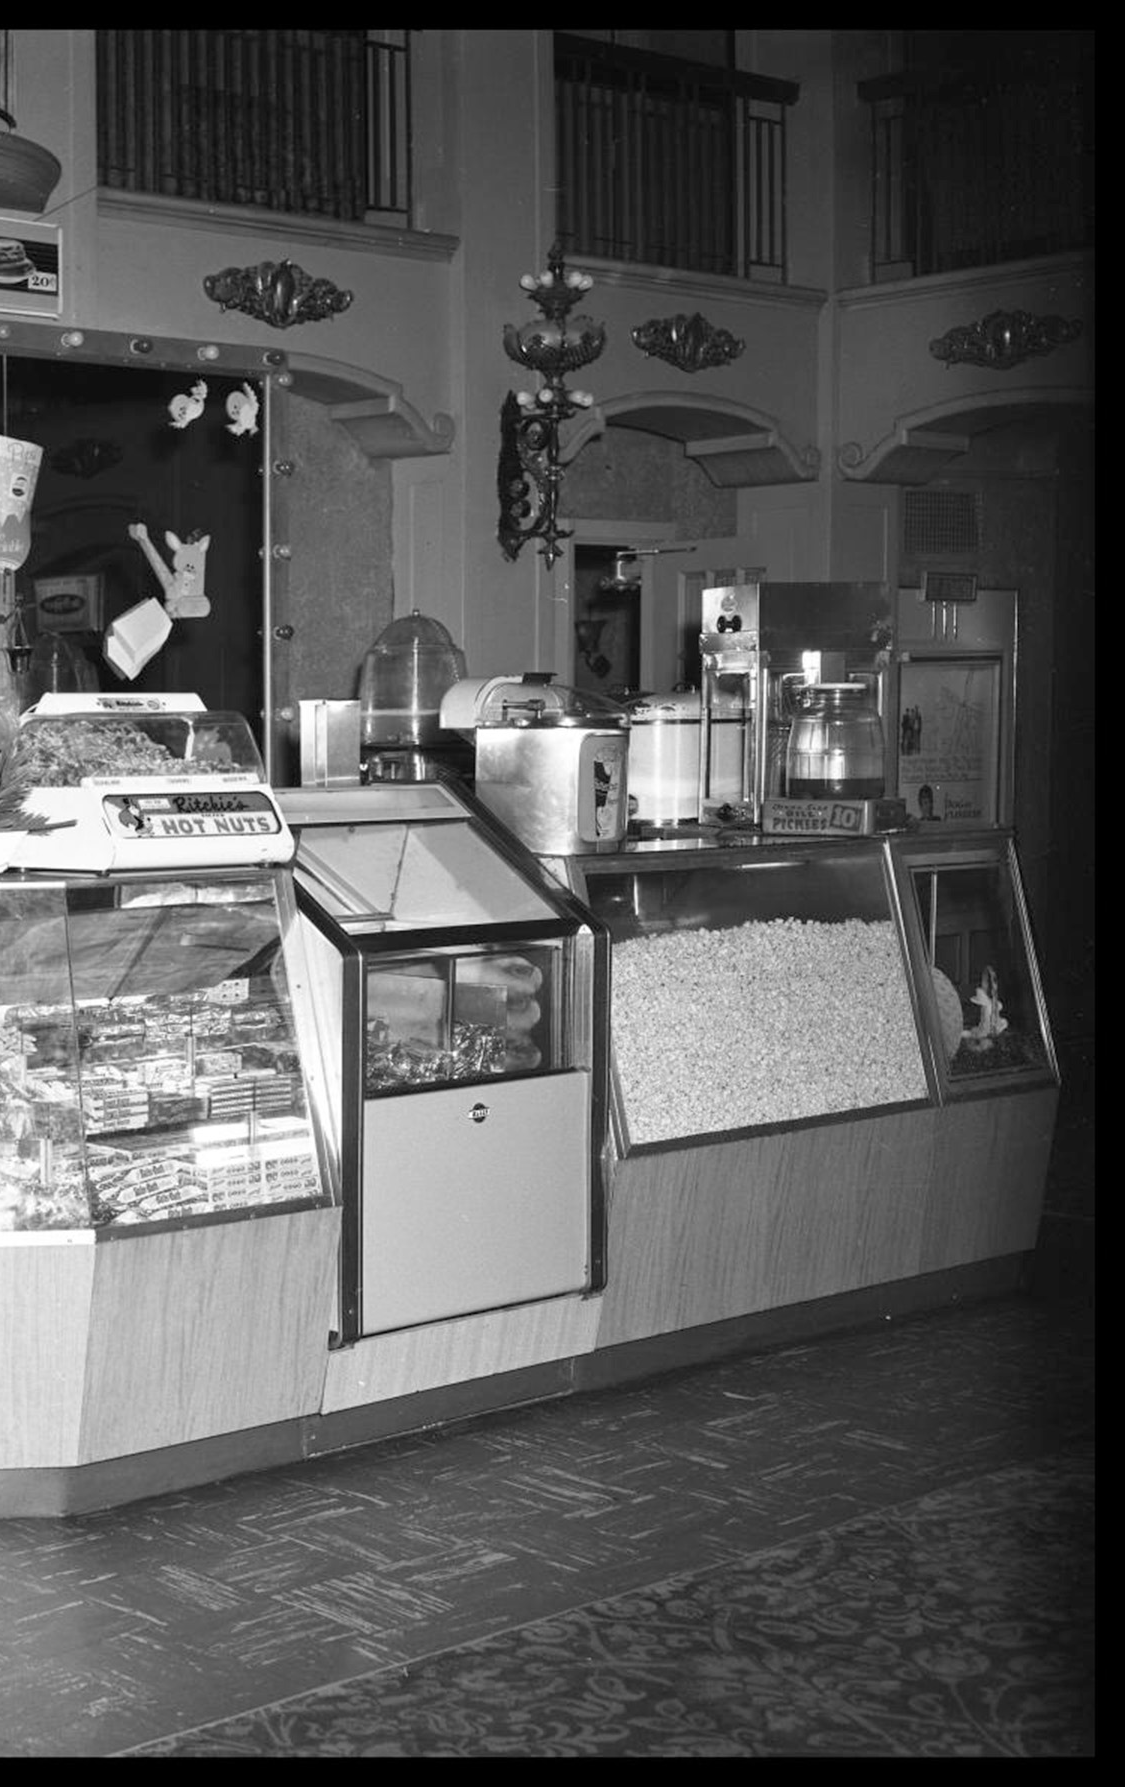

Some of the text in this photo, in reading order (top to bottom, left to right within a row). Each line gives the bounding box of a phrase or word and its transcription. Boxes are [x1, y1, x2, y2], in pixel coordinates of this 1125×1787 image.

[173, 795, 250, 813] Ritchie's
[161, 816, 271, 835] HOT NUTS
[772, 817, 828, 831] PICKLES
